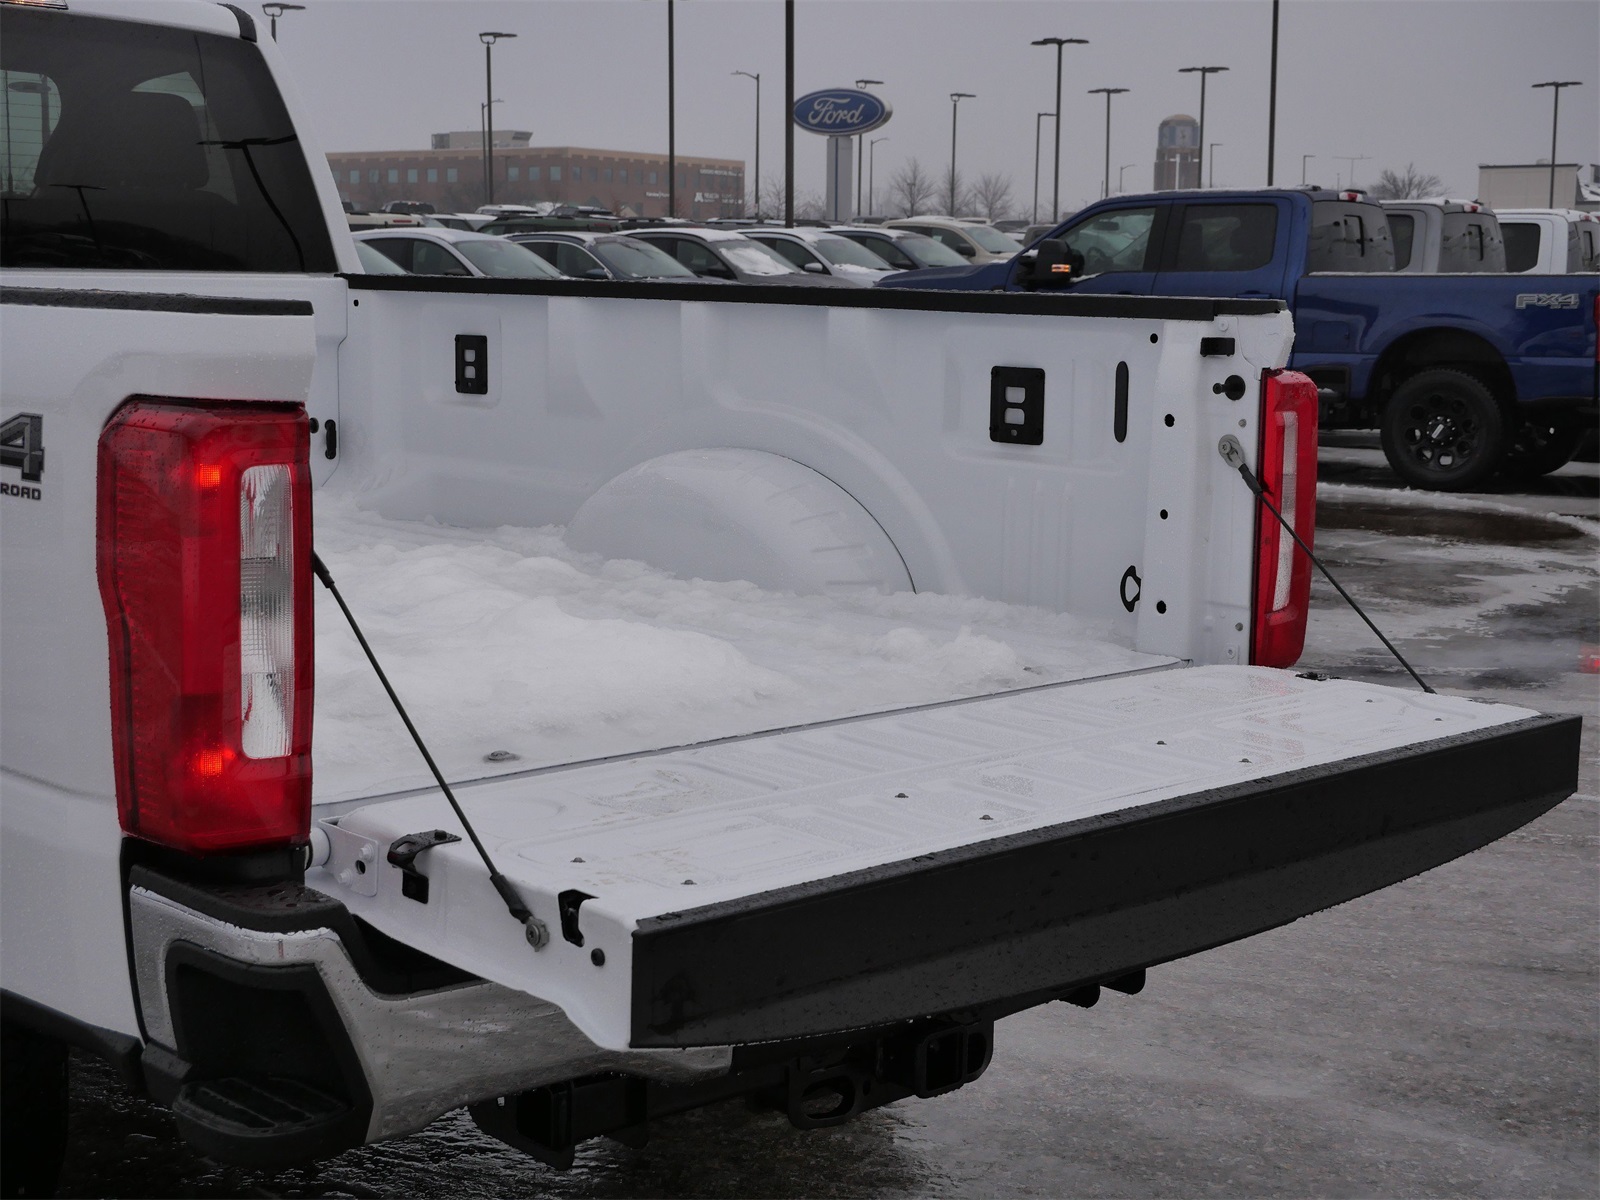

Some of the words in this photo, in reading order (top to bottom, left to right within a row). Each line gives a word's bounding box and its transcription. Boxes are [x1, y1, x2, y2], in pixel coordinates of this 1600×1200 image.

[808, 97, 865, 124] Ford
[1515, 293, 1579, 309] FX4
[0, 482, 42, 500] ROAD
